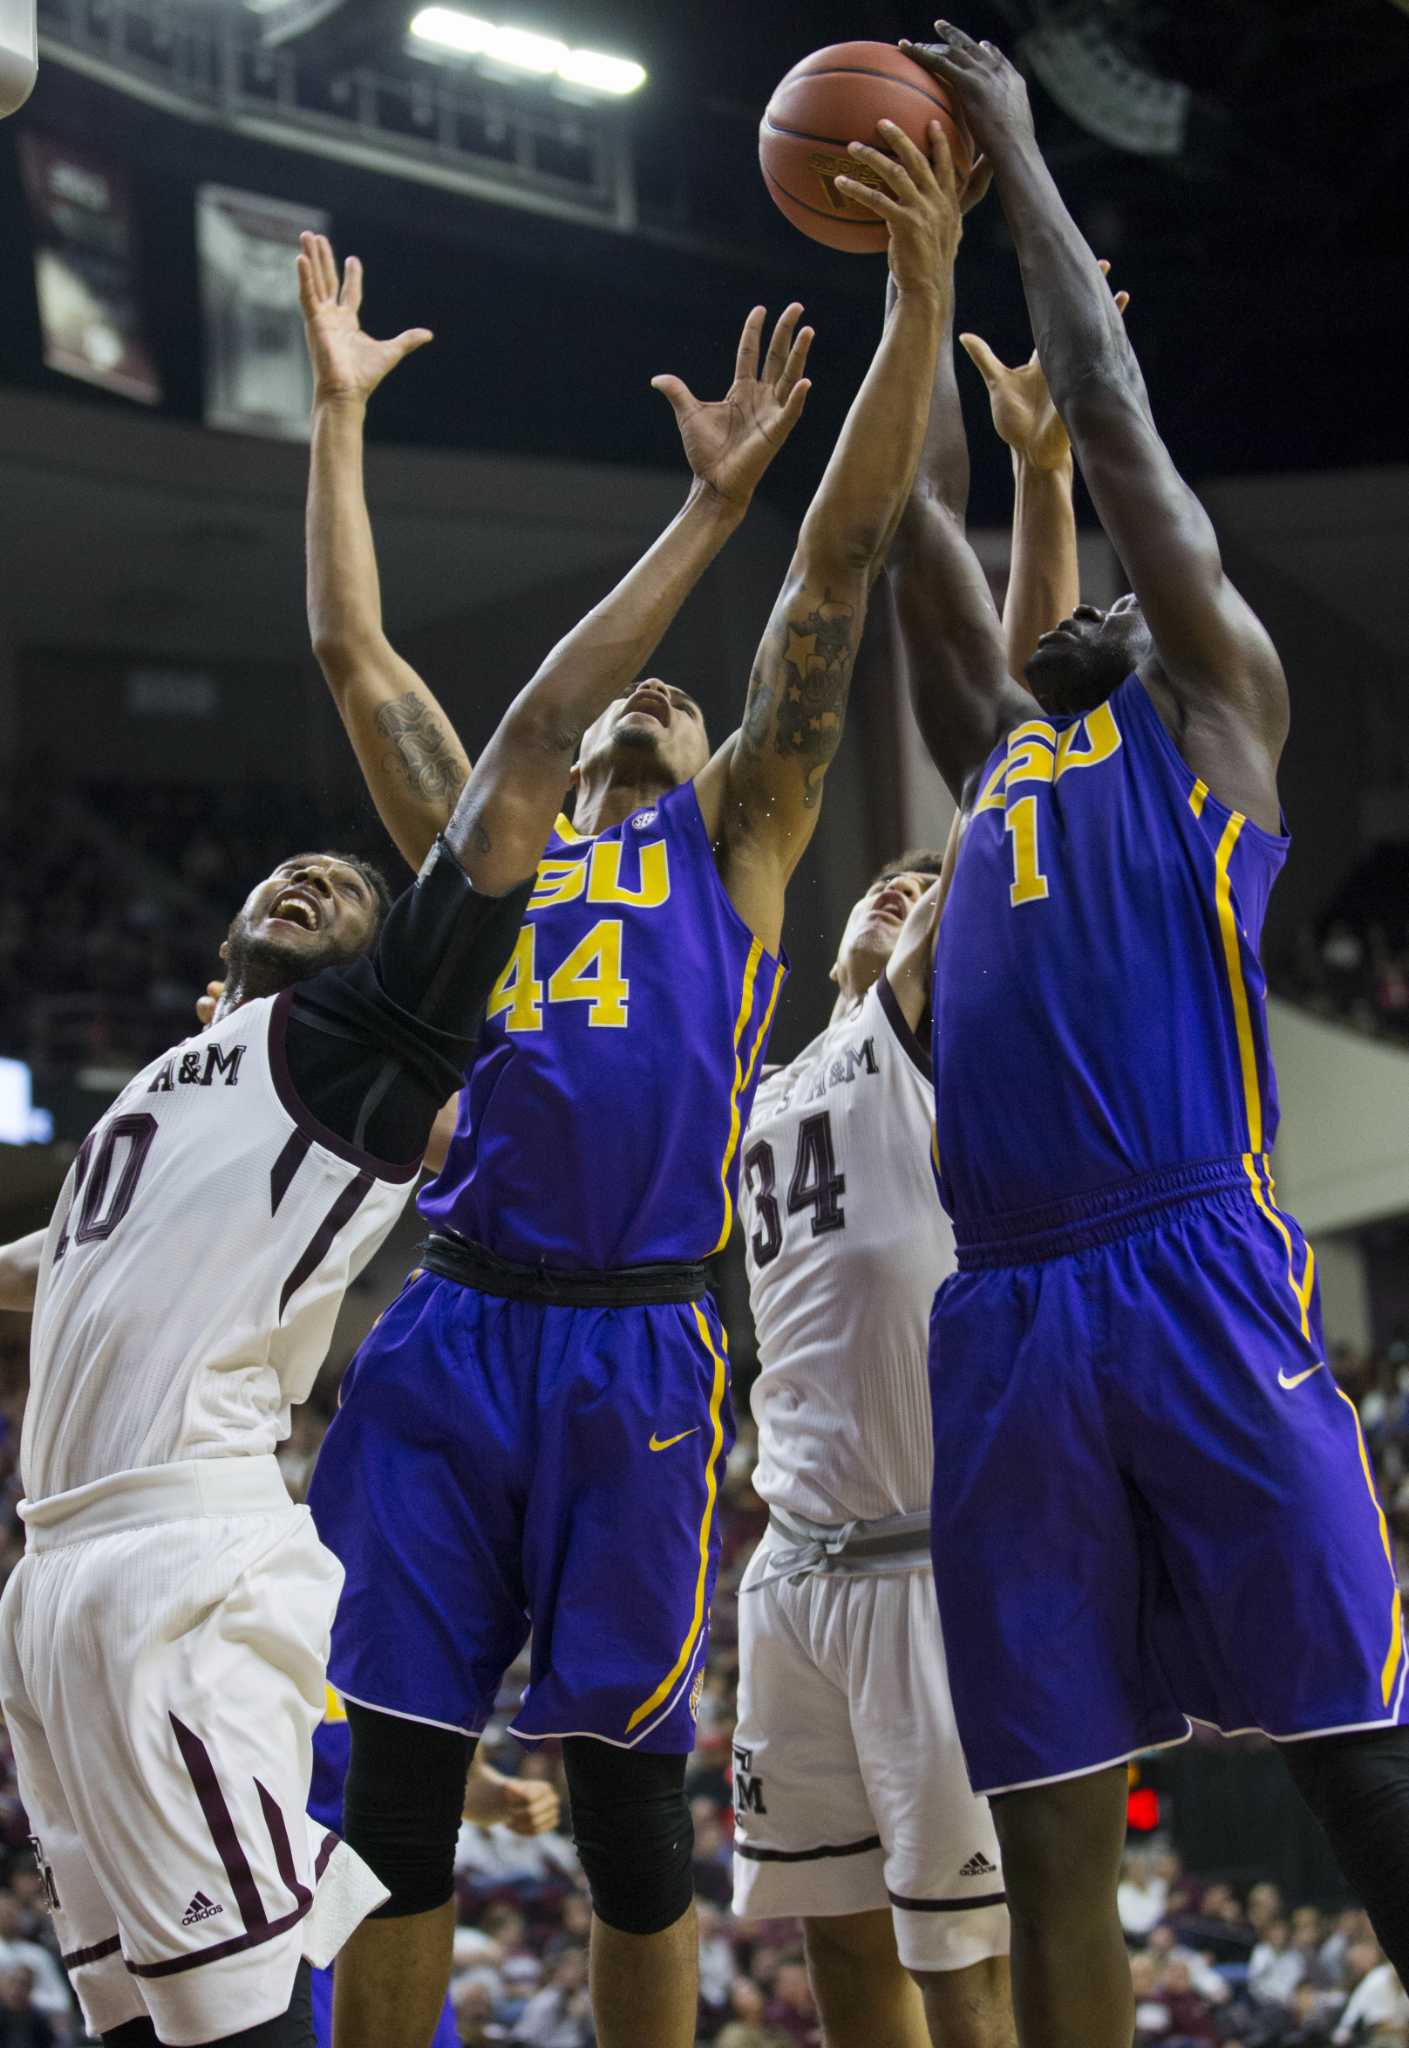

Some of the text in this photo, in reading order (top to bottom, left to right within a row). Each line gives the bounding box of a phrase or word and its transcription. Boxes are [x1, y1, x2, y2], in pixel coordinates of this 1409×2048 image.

[971, 701, 1122, 821] LSU
[526, 839, 670, 912] SU
[1005, 795, 1049, 908] 1
[486, 919, 629, 1032] 44
[148, 1043, 247, 1093] A&M
[744, 1110, 846, 1269] 34
[182, 1904, 224, 1926] adidas
